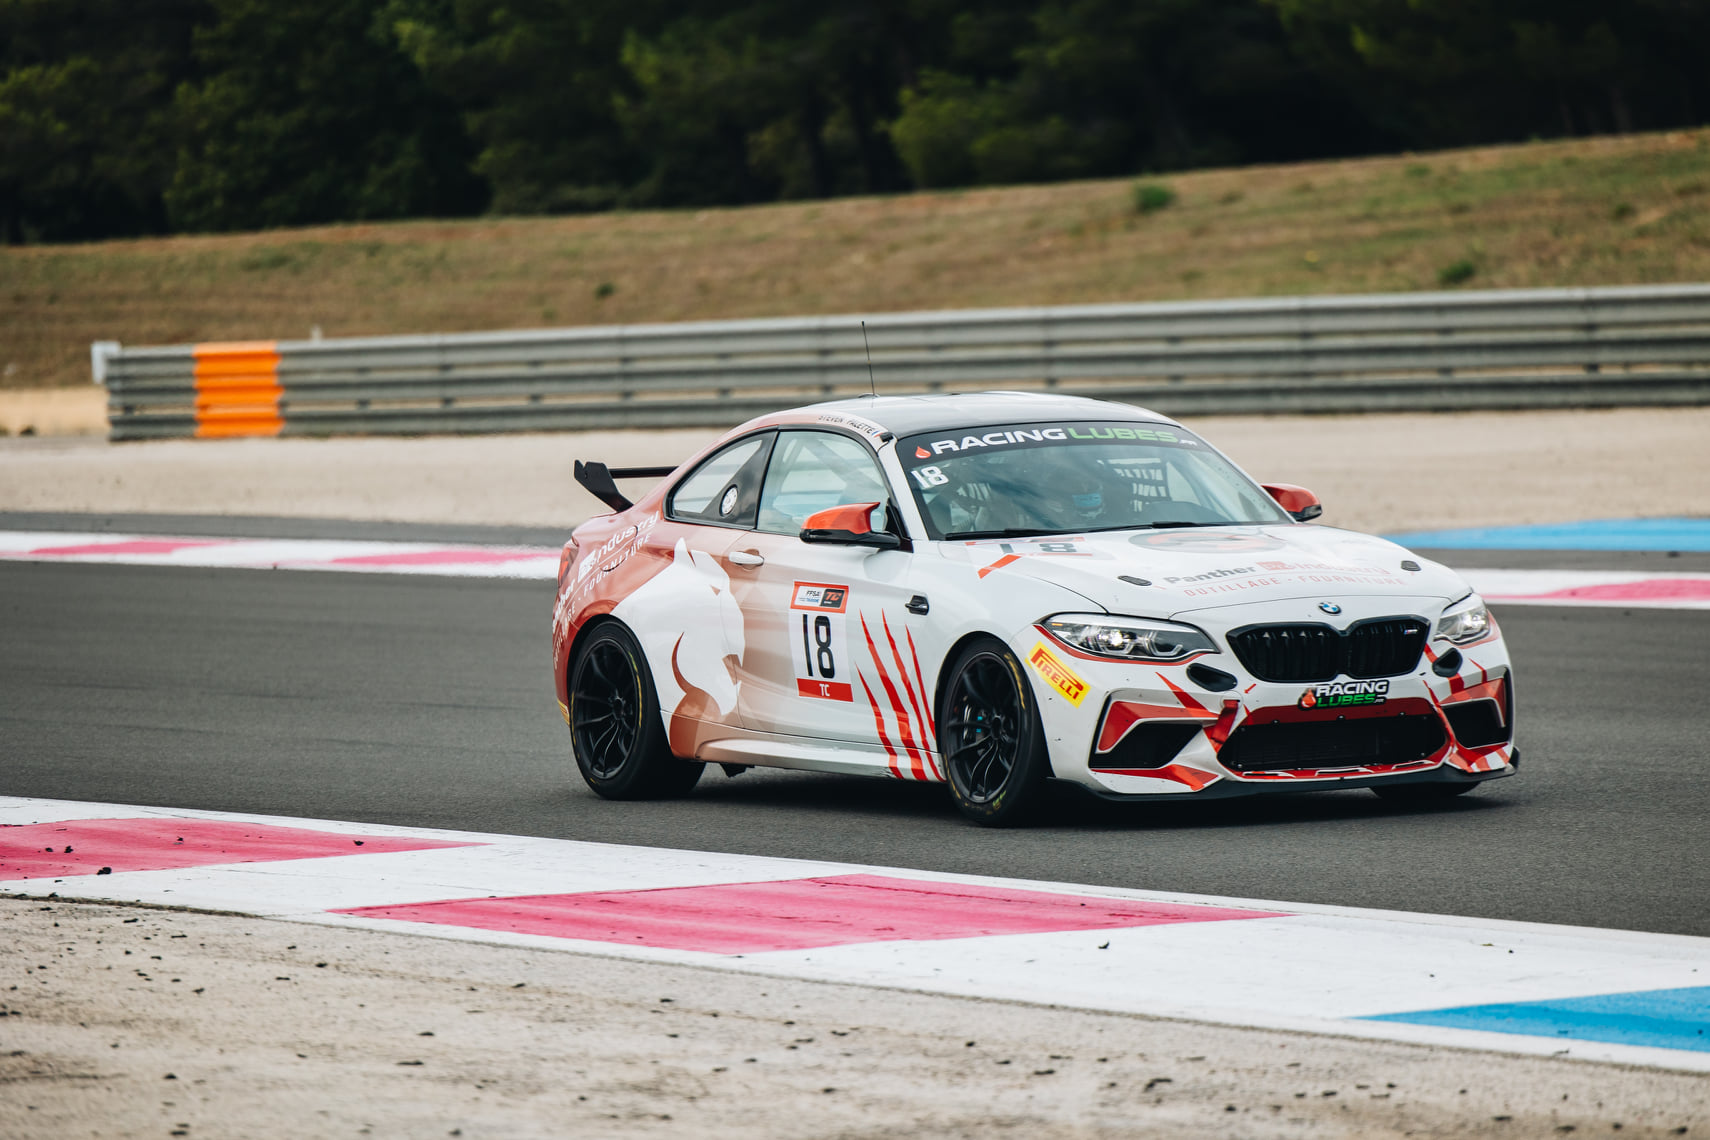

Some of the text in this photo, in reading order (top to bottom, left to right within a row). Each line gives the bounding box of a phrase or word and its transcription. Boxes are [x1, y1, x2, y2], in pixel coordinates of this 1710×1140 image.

[911, 466, 949, 489] 18
[1163, 566, 1256, 584] Panther
[1184, 576, 1281, 597] OUTILLAGE
[825, 591, 842, 602] TC
[802, 613, 835, 679] 18
[1030, 647, 1084, 700] PIRELLI
[819, 683, 830, 697] TC
[1316, 681, 1388, 697] RACING
[1317, 693, 1376, 708] LUBES
